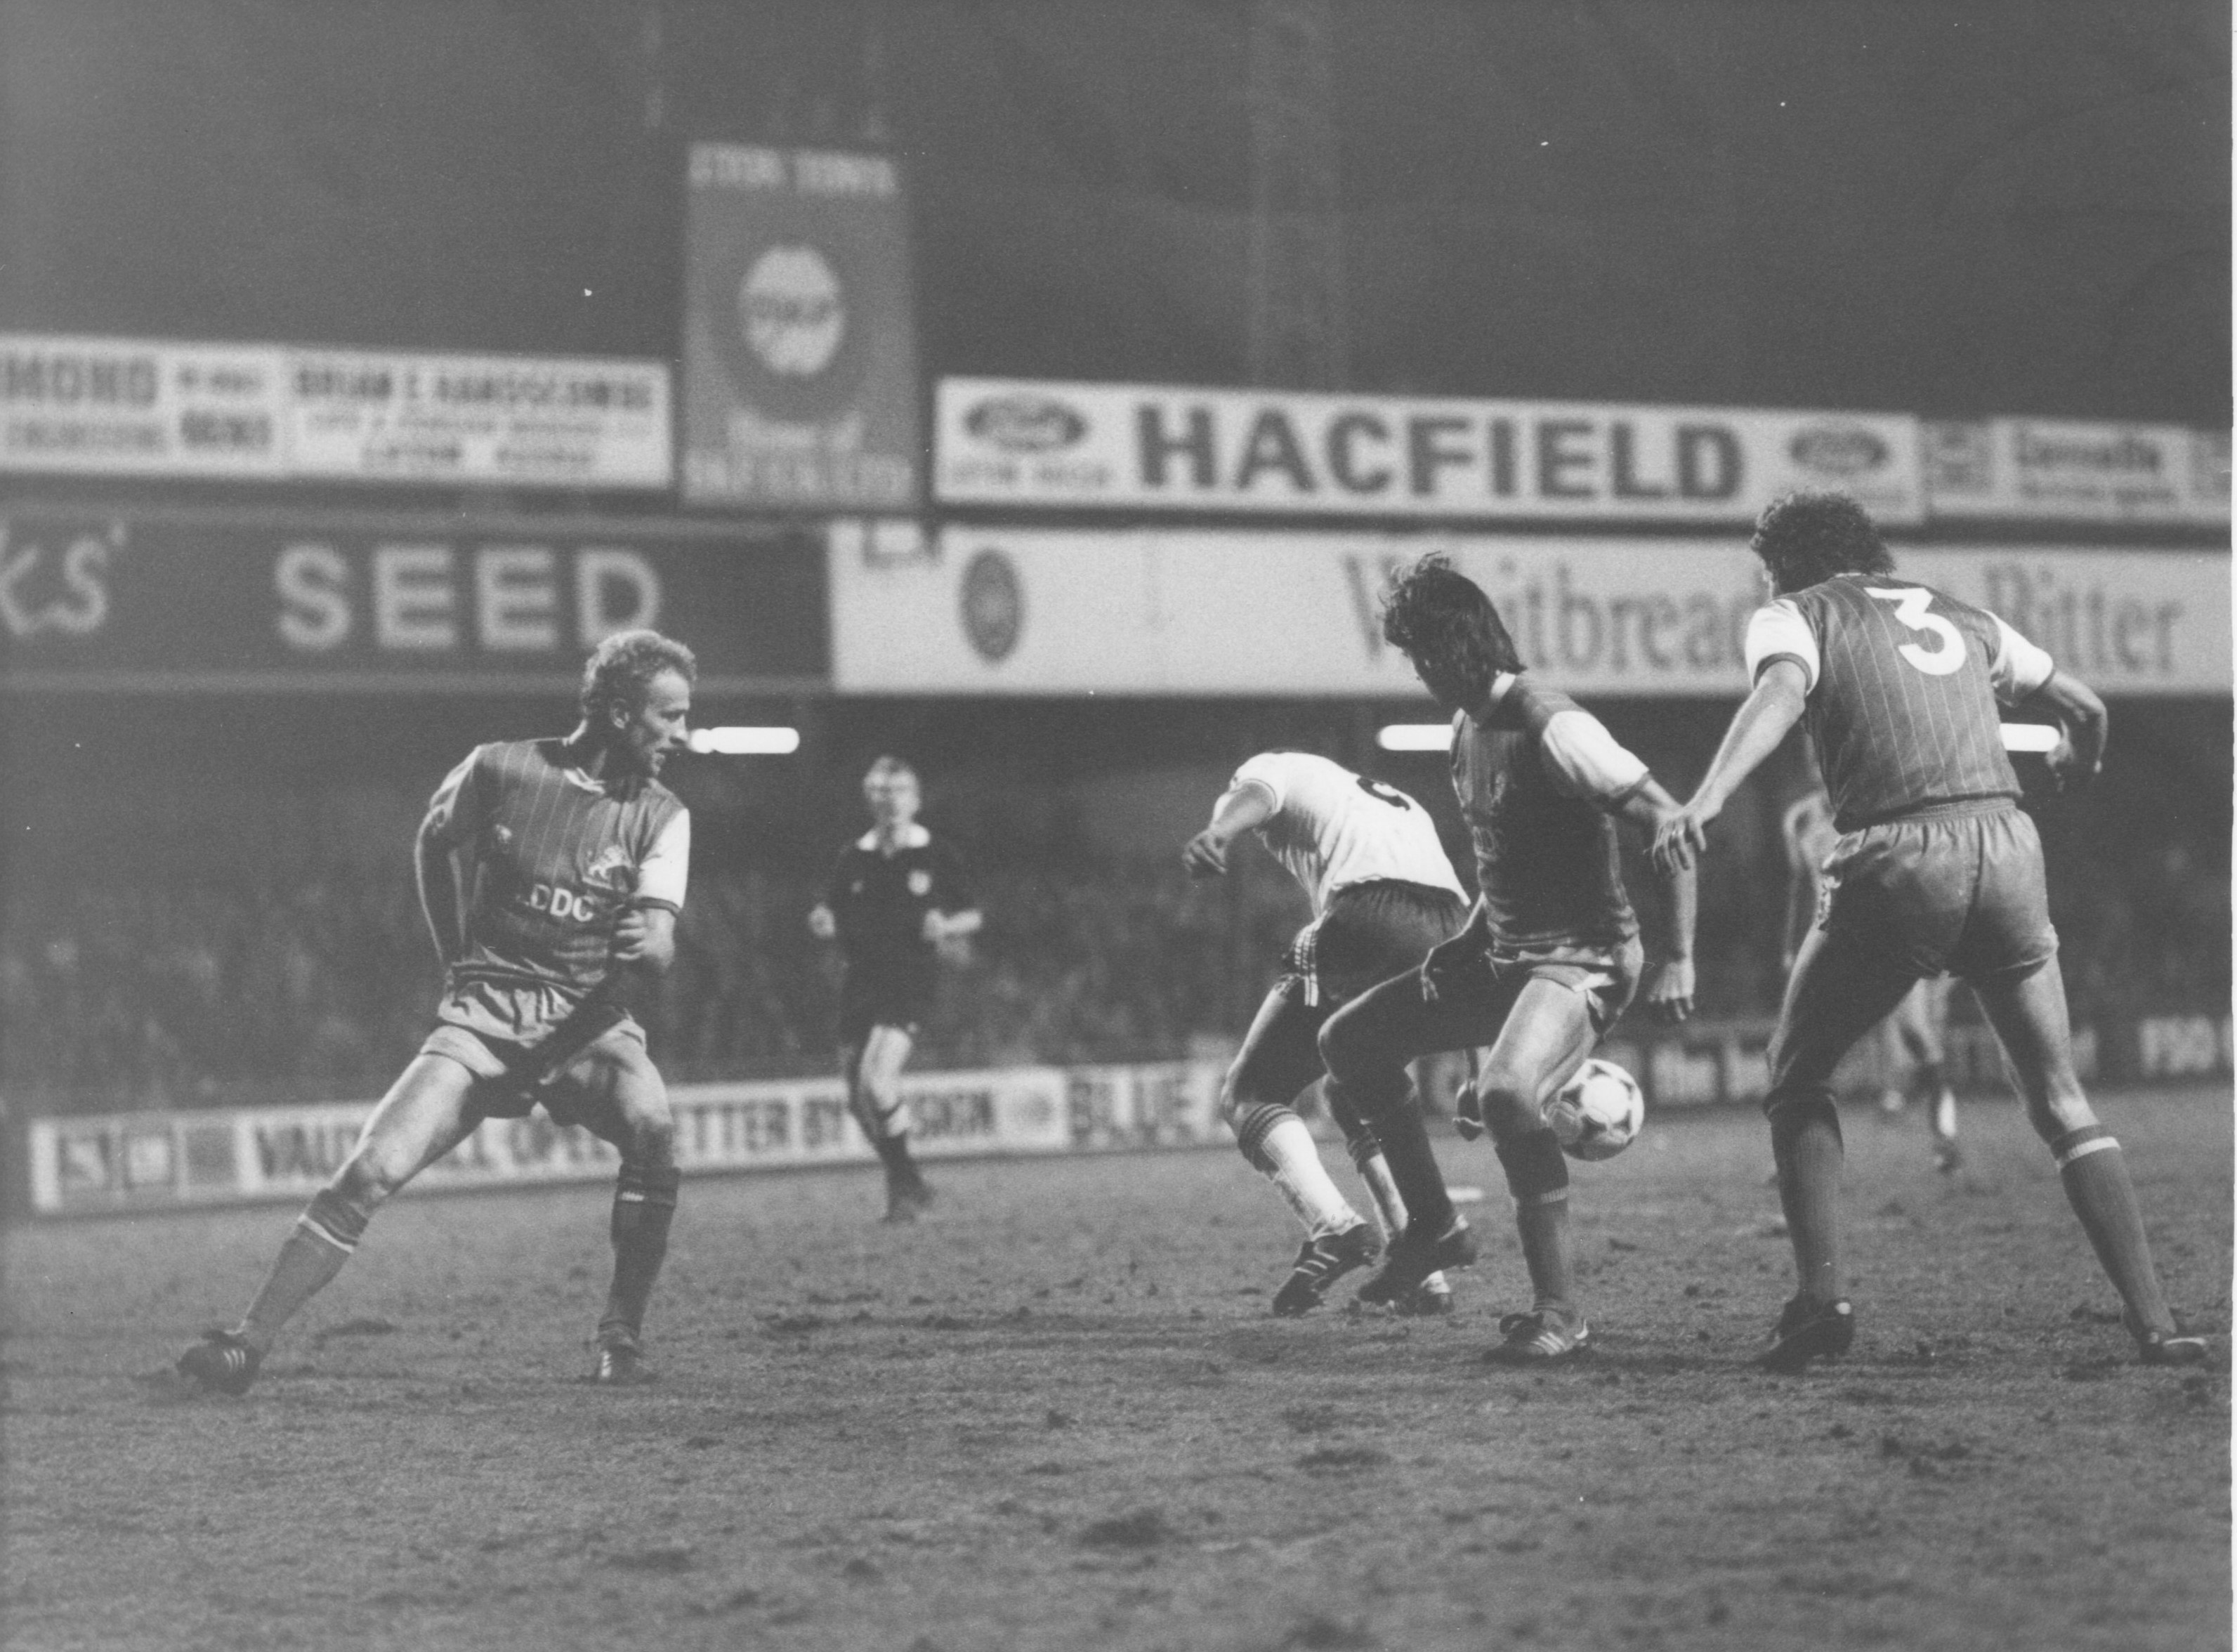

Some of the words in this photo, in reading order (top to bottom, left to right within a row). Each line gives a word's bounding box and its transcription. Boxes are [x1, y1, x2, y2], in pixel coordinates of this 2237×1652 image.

[1136, 403, 1745, 500] HACFIELD
[277, 545, 660, 650] SEED
[1863, 587, 1966, 676] 3
[515, 884, 595, 922] DDC
